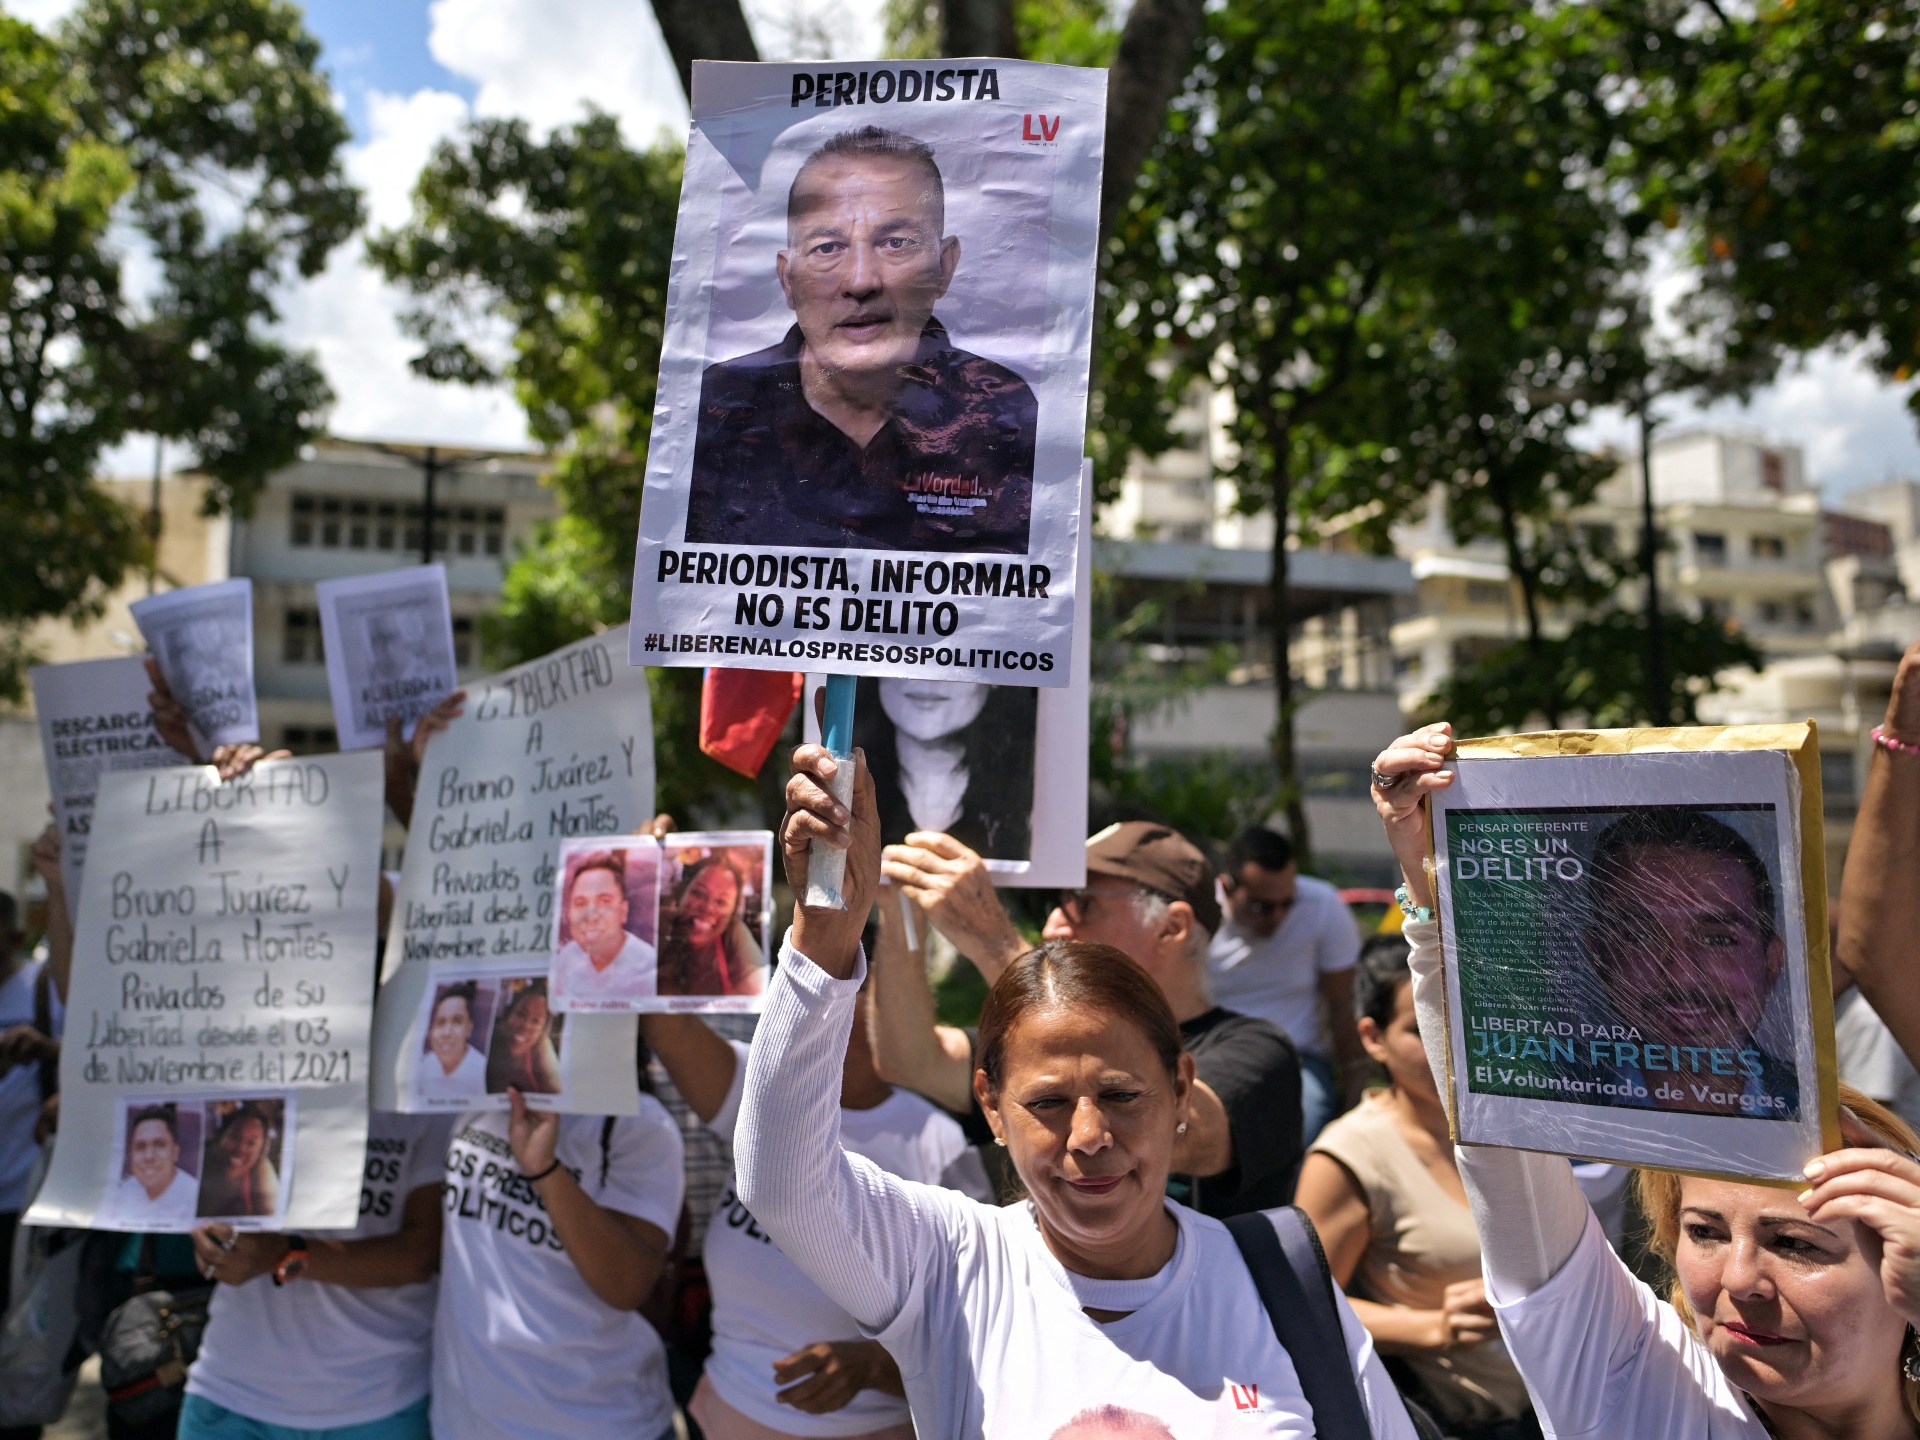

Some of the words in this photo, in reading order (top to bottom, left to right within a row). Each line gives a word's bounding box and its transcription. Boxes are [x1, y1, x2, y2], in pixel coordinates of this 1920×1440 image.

[791, 69, 1000, 107] PERIODISTA
[1022, 113, 1060, 142] LV
[657, 550, 860, 595] PERIODISTA,
[870, 558, 1051, 599] INFORMAR
[735, 593, 784, 627] NO
[793, 596, 831, 630] ES
[841, 598, 959, 637] DELITO
[644, 633, 1054, 672] #LIBERENALOSPRESOSPOLITICOS
[525, 720, 543, 755] A
[438, 767, 514, 808] Bruno
[531, 753, 613, 794] Juárez
[194, 817, 224, 865] A
[1459, 823, 1510, 833] PENSAR
[1513, 822, 1589, 833] DIFERENTE
[1461, 838, 1494, 854] NO
[1501, 838, 1528, 854] ES
[1534, 838, 1568, 854] UN
[433, 858, 520, 895] Privados
[1456, 857, 1583, 880] DELITO
[112, 870, 196, 921] Bruno
[208, 869, 311, 918] Juárez
[327, 863, 349, 909] Y
[484, 893, 529, 923] desde
[1460, 909, 1510, 917] secuestrado
[404, 930, 486, 961] Noviembre
[1461, 928, 1494, 936] cuerpos
[1509, 929, 1561, 938] inteligencia
[1463, 936, 1491, 944] Estado
[1489, 946, 1500, 954] de
[121, 969, 226, 1012] Privados
[254, 969, 284, 1008] de
[1474, 1000, 1508, 1009] Liberen
[1511, 984, 1530, 992] vida
[197, 1013, 258, 1048] desde
[267, 1019, 286, 1046] el
[295, 1017, 330, 1047] 03
[1471, 1015, 1574, 1037] LIBERTAD
[1580, 1023, 1643, 1041] PARA
[83, 1051, 109, 1084] de
[118, 1050, 244, 1085] Noviembre
[251, 1051, 285, 1084] del
[290, 1049, 351, 1083] 2021
[1472, 1031, 1575, 1064] JUAN
[1590, 1040, 1764, 1077] FREITES
[1475, 1066, 1493, 1084] El
[1496, 1067, 1648, 1098] Voluntariado
[1654, 1081, 1685, 1101] de
[1690, 1083, 1786, 1112] Vargas
[1230, 1383, 1259, 1410] LV
